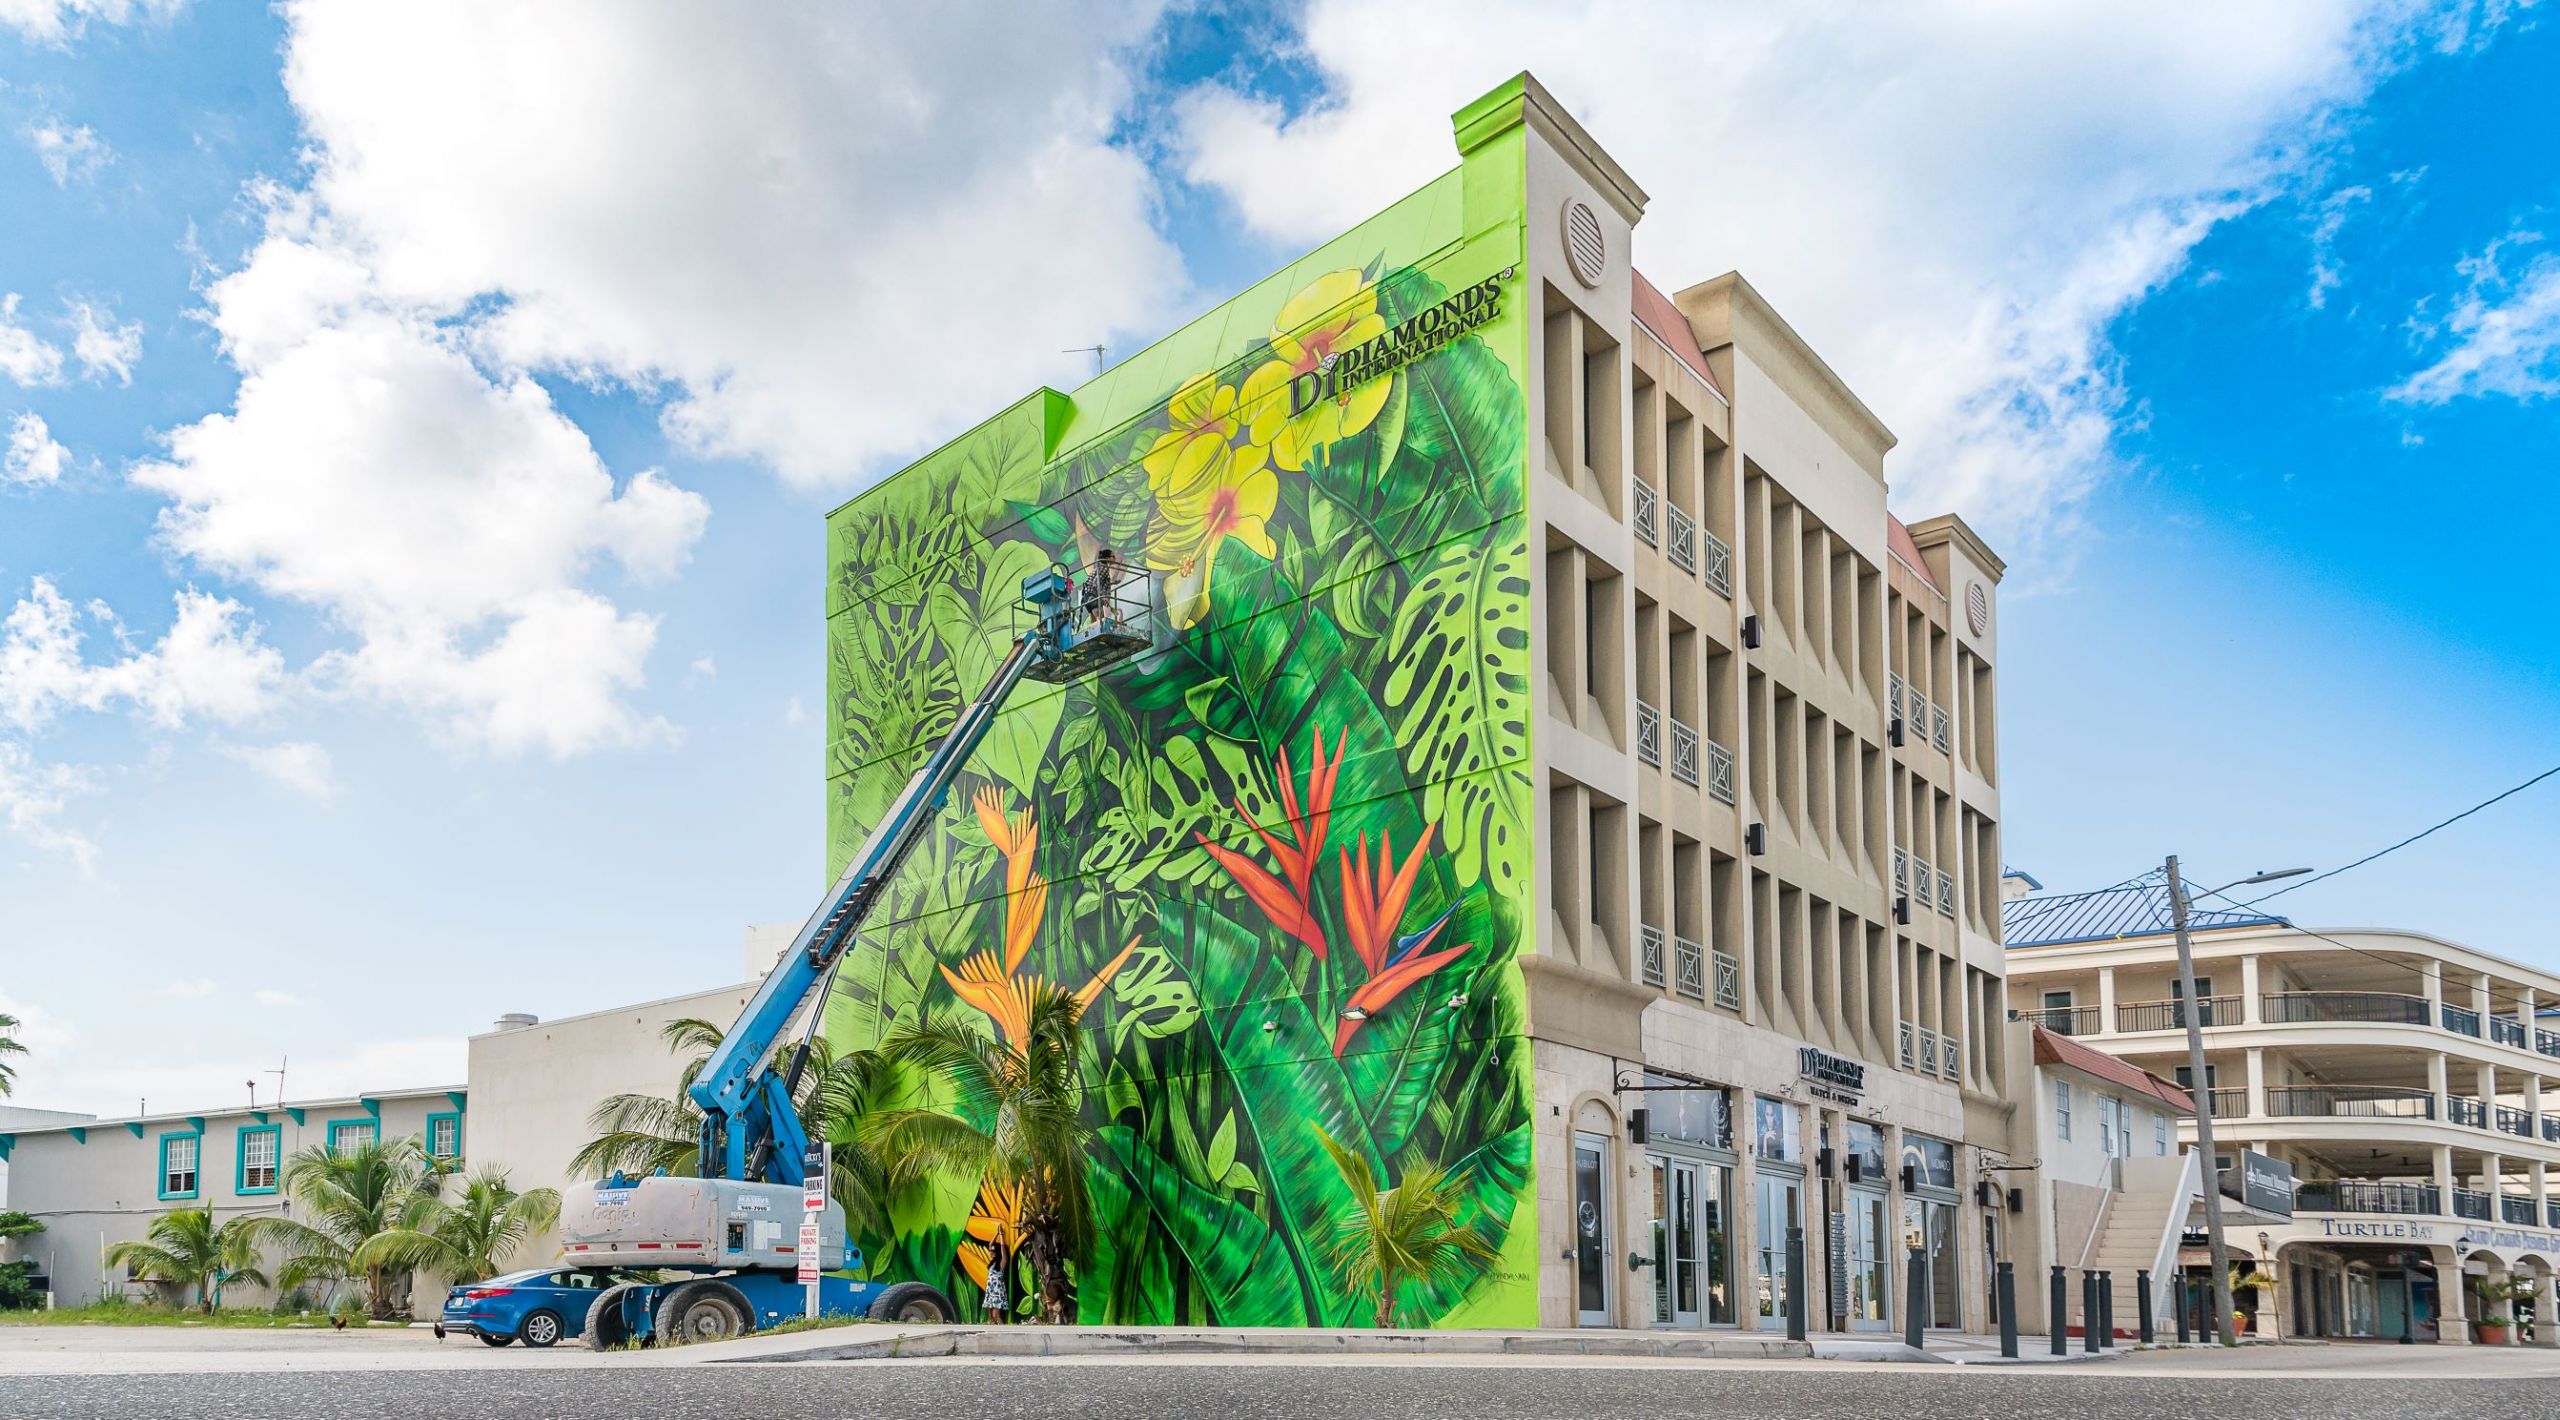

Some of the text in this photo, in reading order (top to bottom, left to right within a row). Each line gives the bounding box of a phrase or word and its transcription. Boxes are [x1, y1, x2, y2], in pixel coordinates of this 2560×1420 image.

[1342, 301, 1501, 391] INTERNATIONAL
[805, 1179, 823, 1191] PARKING
[2321, 1218, 2434, 1238] TURTLE BAY
